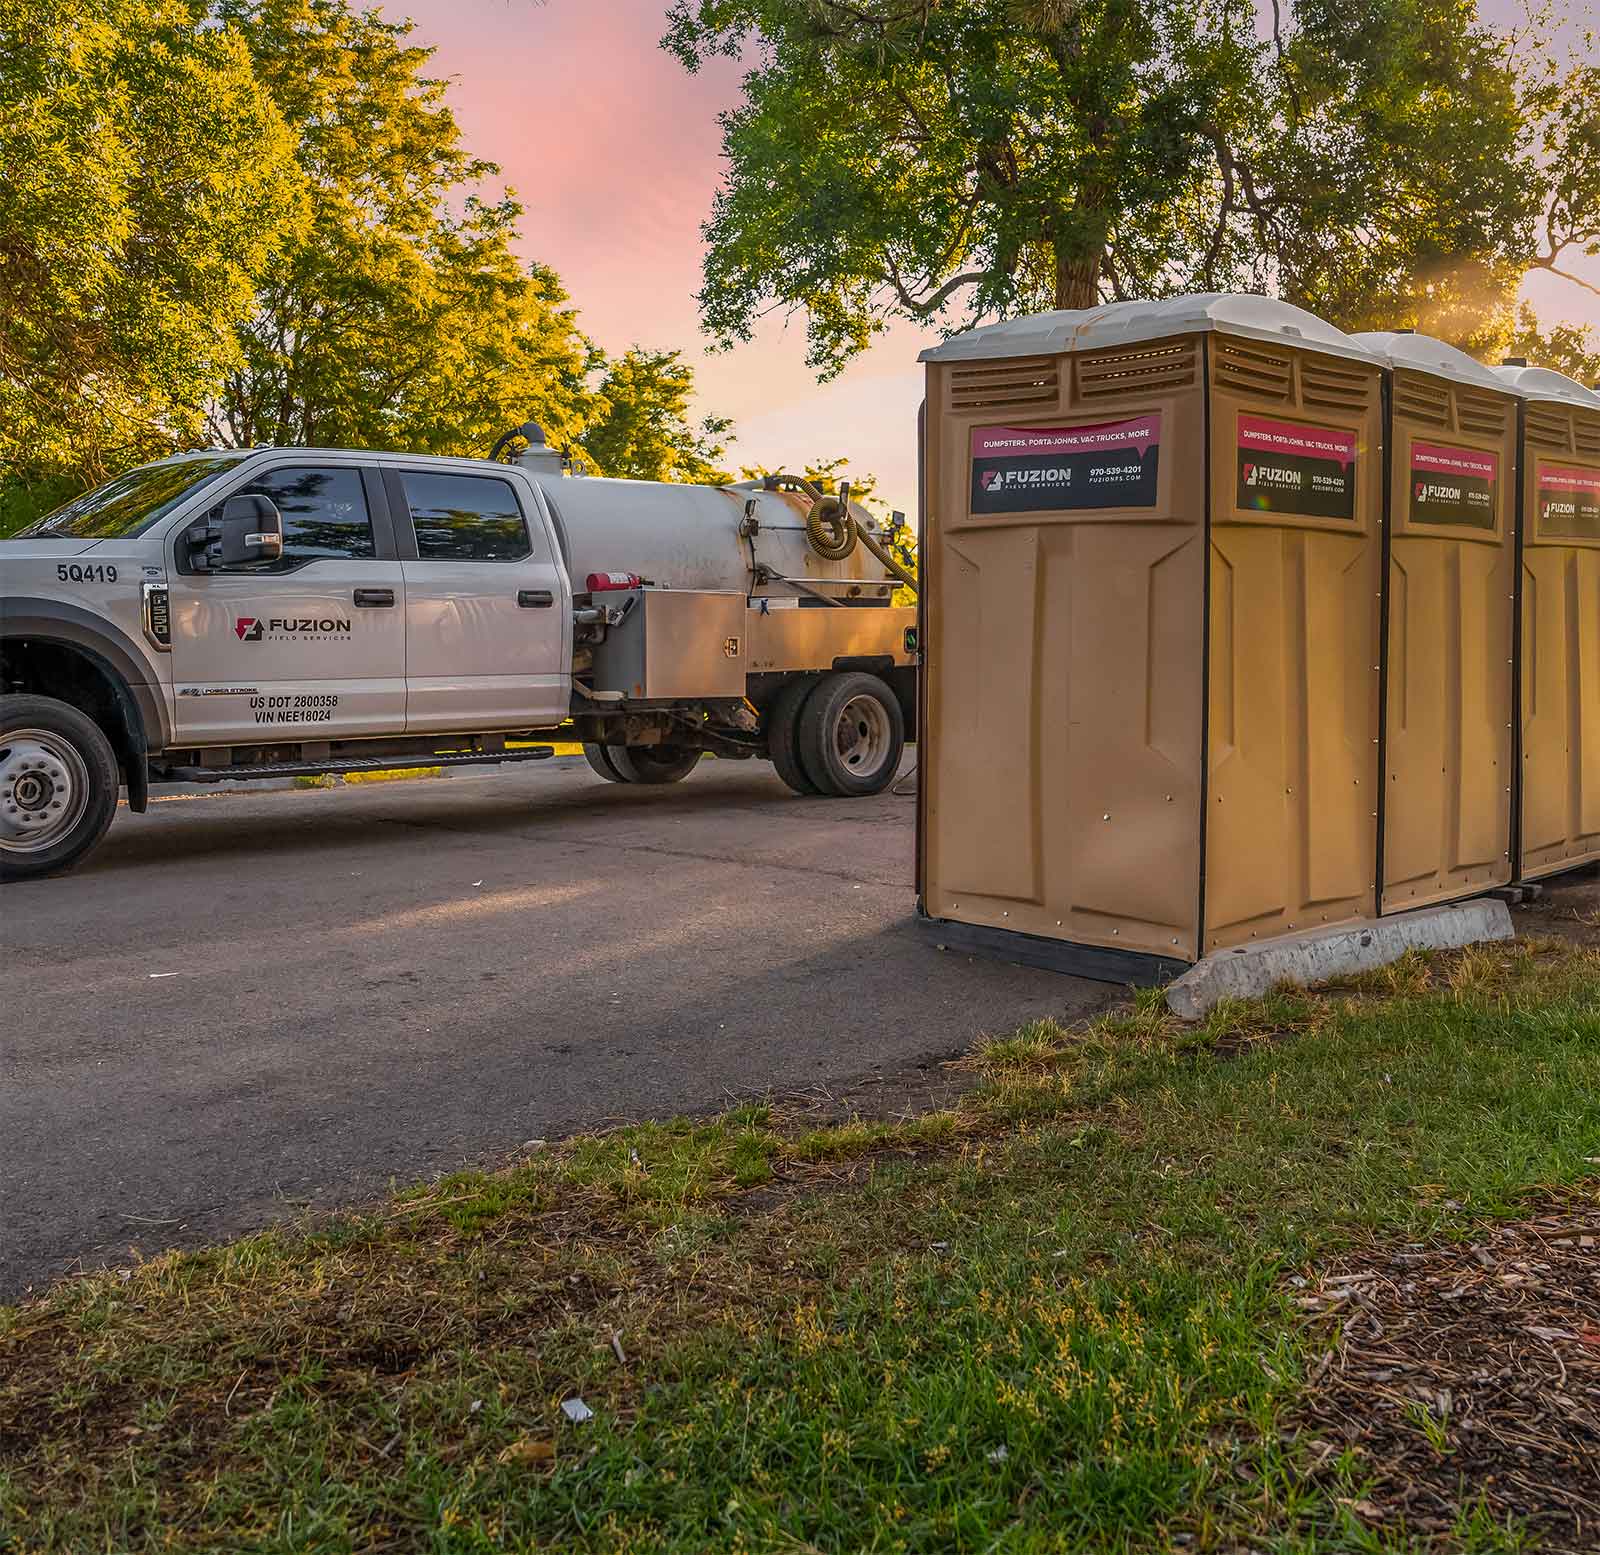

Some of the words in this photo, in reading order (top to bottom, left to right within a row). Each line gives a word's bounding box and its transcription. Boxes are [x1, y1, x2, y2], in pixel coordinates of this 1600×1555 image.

[983, 439, 1027, 448] DUMPSTERS,
[1028, 436, 1079, 446] PORTA-JOHNS,
[1081, 435, 1094, 444] VAC
[1096, 432, 1127, 442] TRUCKS,
[1128, 429, 1150, 438] MORE
[1005, 468, 1072, 483] FUZION
[1090, 466, 1142, 476] 970-539-4201
[1259, 466, 1301, 484] FUZION
[1032, 481, 1071, 489] SERVICES
[1428, 485, 1460, 499] FUZION
[1550, 502, 1575, 513] FUZION
[57, 564, 118, 582] 5Q419
[269, 619, 351, 632] FUZION
[250, 697, 265, 708] US
[269, 696, 291, 708] DOT
[294, 695, 338, 707] 2800358
[255, 711, 274, 723] VIN
[277, 710, 331, 722] NEE18024
